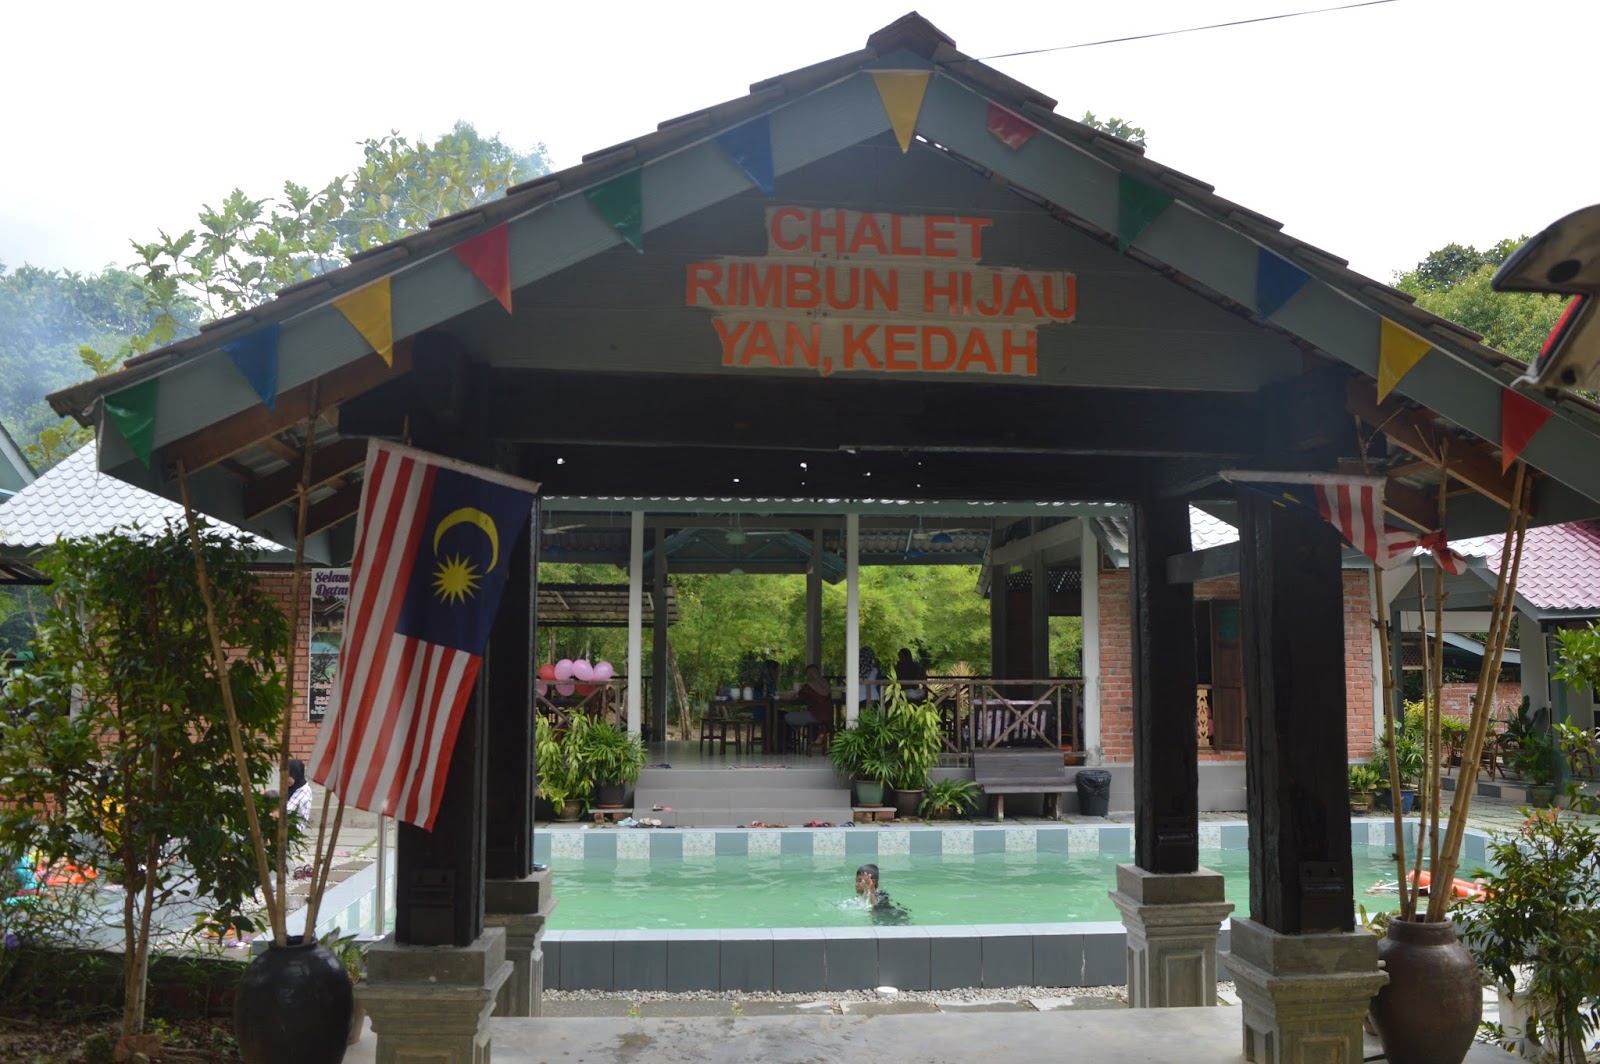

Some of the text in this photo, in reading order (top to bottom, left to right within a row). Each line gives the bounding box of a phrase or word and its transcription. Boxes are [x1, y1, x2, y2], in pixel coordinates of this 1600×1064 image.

[771, 208, 993, 259] CHALET
[686, 262, 1077, 319] RIMBUN HIJAU
[713, 319, 1038, 377] YAN, KEDAH
[314, 570, 350, 583] Selam
